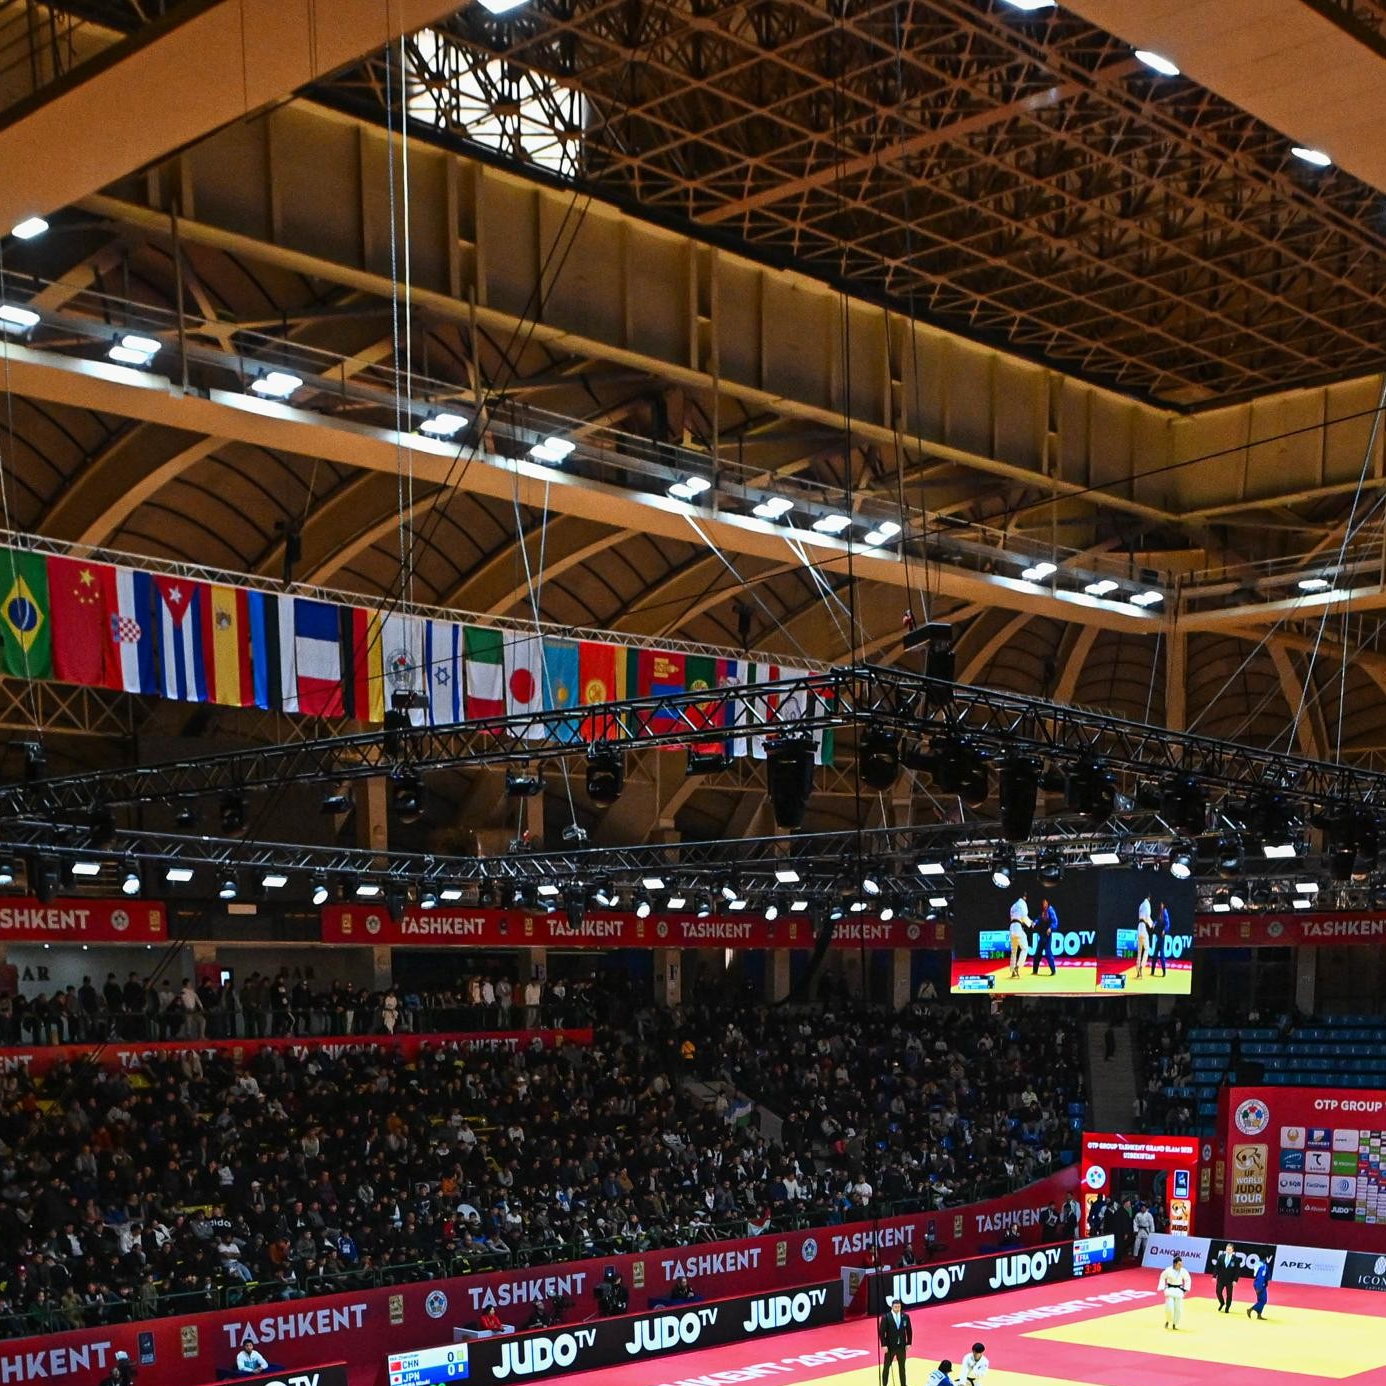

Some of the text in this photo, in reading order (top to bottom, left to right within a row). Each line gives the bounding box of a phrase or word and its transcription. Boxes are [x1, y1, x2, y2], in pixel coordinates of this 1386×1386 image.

[401, 918, 485, 935] TASHKENT
[547, 920, 623, 936] TASHKENT
[681, 921, 751, 939] TASHKENT
[830, 924, 892, 940] SHKENT
[1079, 931, 1096, 945] TV
[1314, 1099, 1338, 1110] OTP
[1340, 1100, 1382, 1112] GROUP
[1235, 1184, 1263, 1194] JUDO
[1236, 1177, 1263, 1185] WORLD
[1235, 1194, 1262, 1203] TOUR
[976, 1206, 1047, 1233] TASHKEN
[832, 1225, 914, 1254] TASHKENT
[1159, 1249, 1201, 1259] ANORBANK
[662, 1248, 761, 1280] TASHKENT
[989, 1248, 1061, 1289] JUDO TV
[1280, 1260, 1312, 1270] APEX
[469, 1272, 586, 1310] TASHKENT
[885, 1264, 966, 1306] JUDO TV
[743, 1288, 827, 1333] JUDO TV
[952, 1289, 1158, 1330] TASHKENT 2025
[223, 1304, 367, 1348] TASHKENT
[625, 1307, 719, 1354] JUDO TV
[403, 1352, 454, 1370] CHN 0
[492, 1328, 597, 1379] JUDO TV
[779, 1347, 870, 1372] 2025
[403, 1364, 455, 1383] JPN 0
